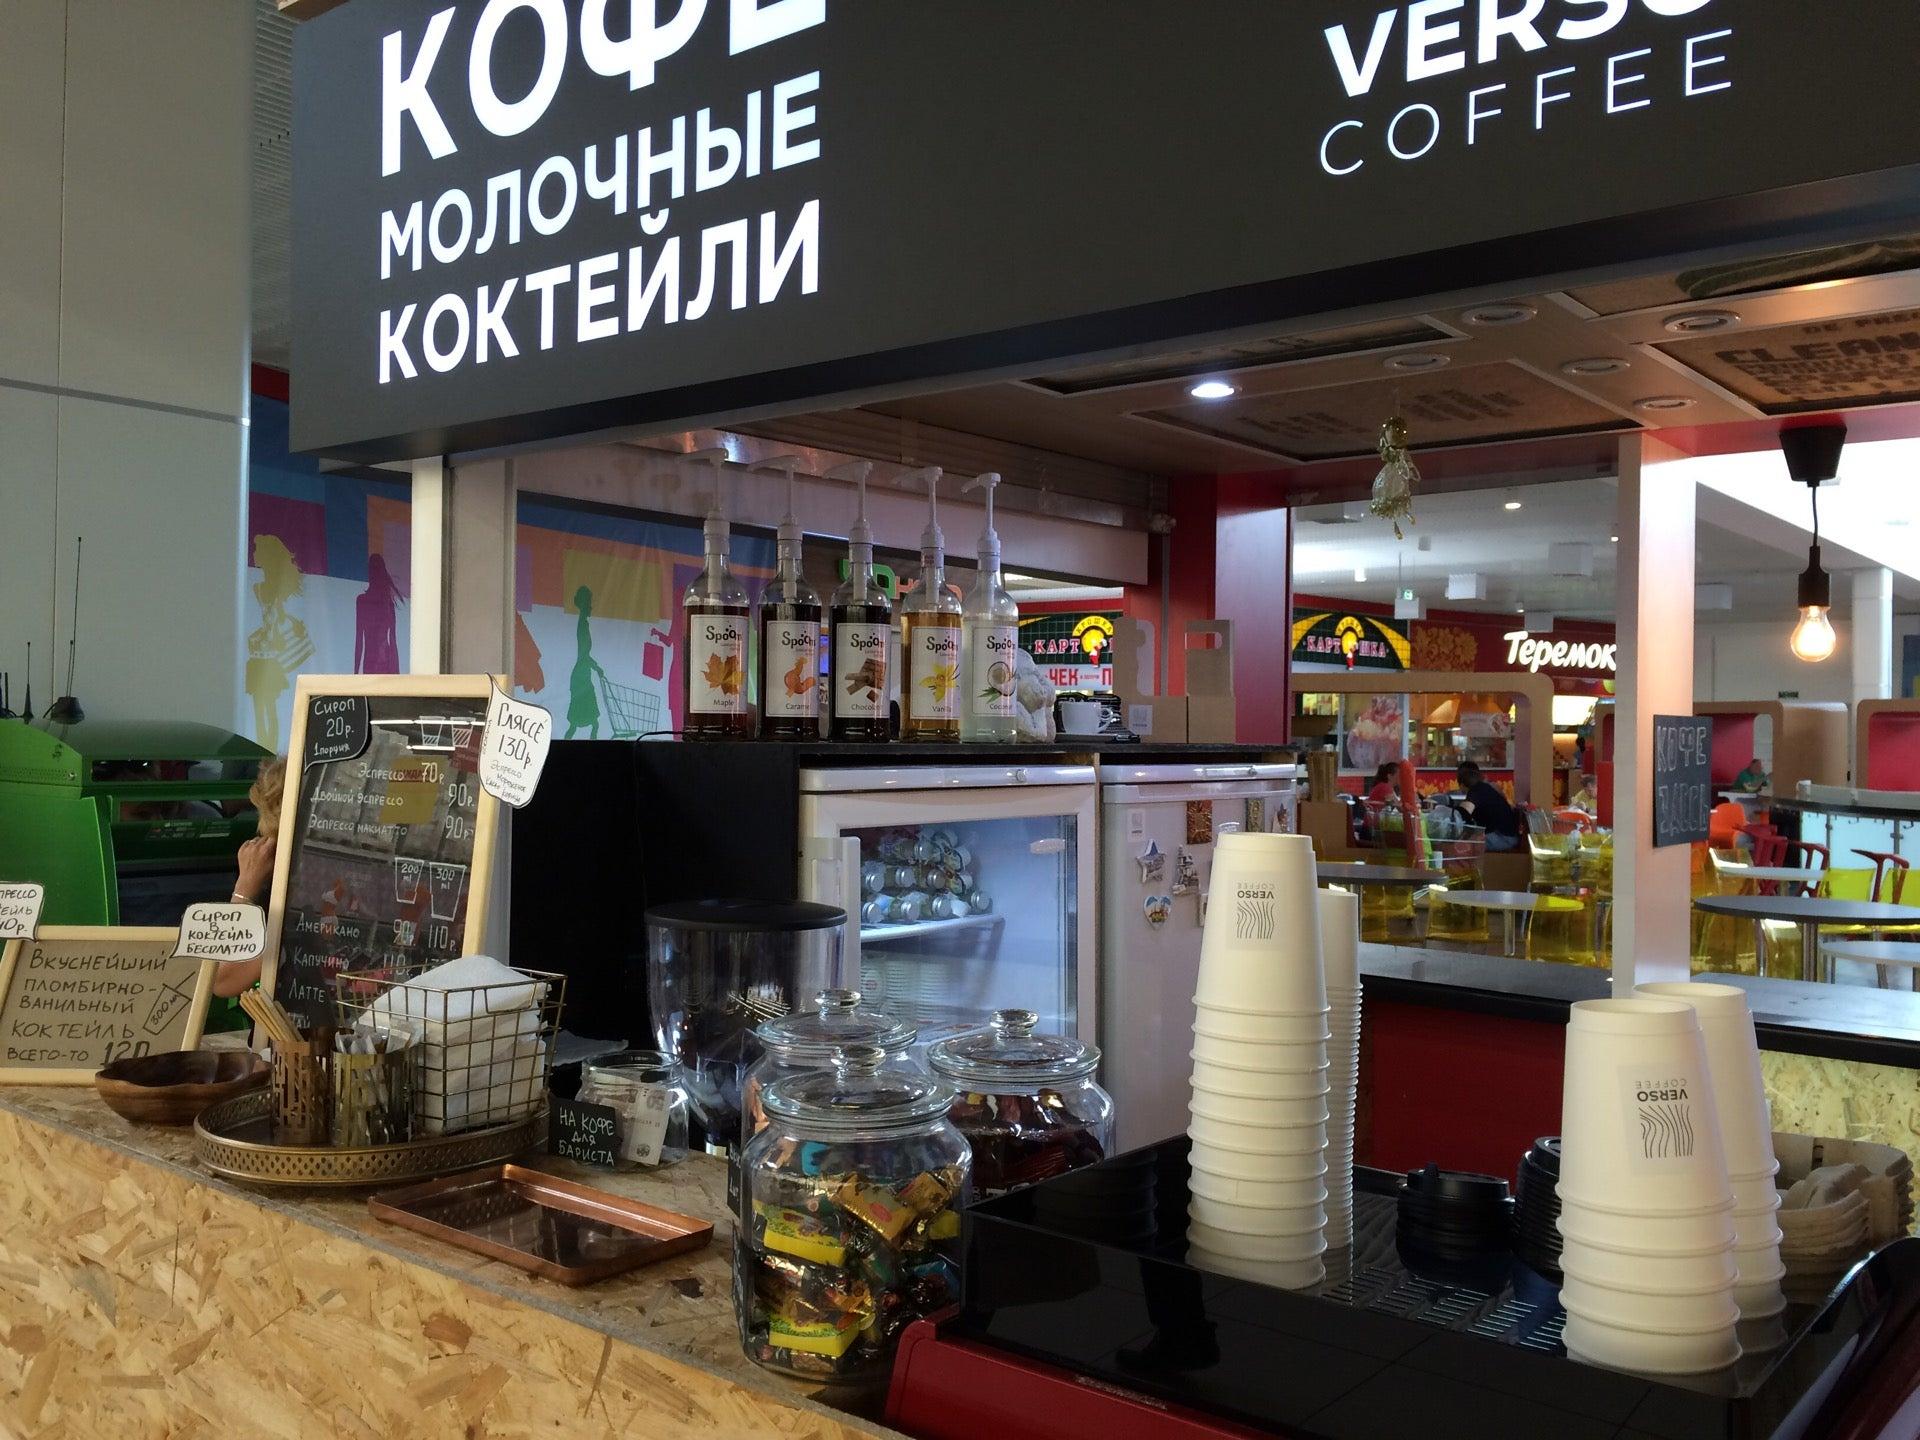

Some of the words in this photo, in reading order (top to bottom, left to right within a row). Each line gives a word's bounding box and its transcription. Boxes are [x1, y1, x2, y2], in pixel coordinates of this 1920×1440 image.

[1324, 0, 1712, 97] VER
[1320, 29, 1732, 175] COFFEE
[380, 70, 821, 280] МОЛОЧНЫЕ
[379, 199, 820, 384] КОКТЕЙЛИ
[1503, 630, 1617, 674] Теремок
[713, 699, 734, 708] Maple
[401, 863, 419, 874] 200
[436, 868, 456, 882] 300
[1237, 882, 1275, 890] COFFEE
[1237, 890, 1274, 900] VERSO
[1635, 1078, 1688, 1090] COFFEE
[1637, 1088, 1689, 1102] VERSO
[559, 1106, 577, 1127] НА
[581, 1112, 615, 1137] КОФЕ
[558, 1139, 615, 1167] БАРИСТА
